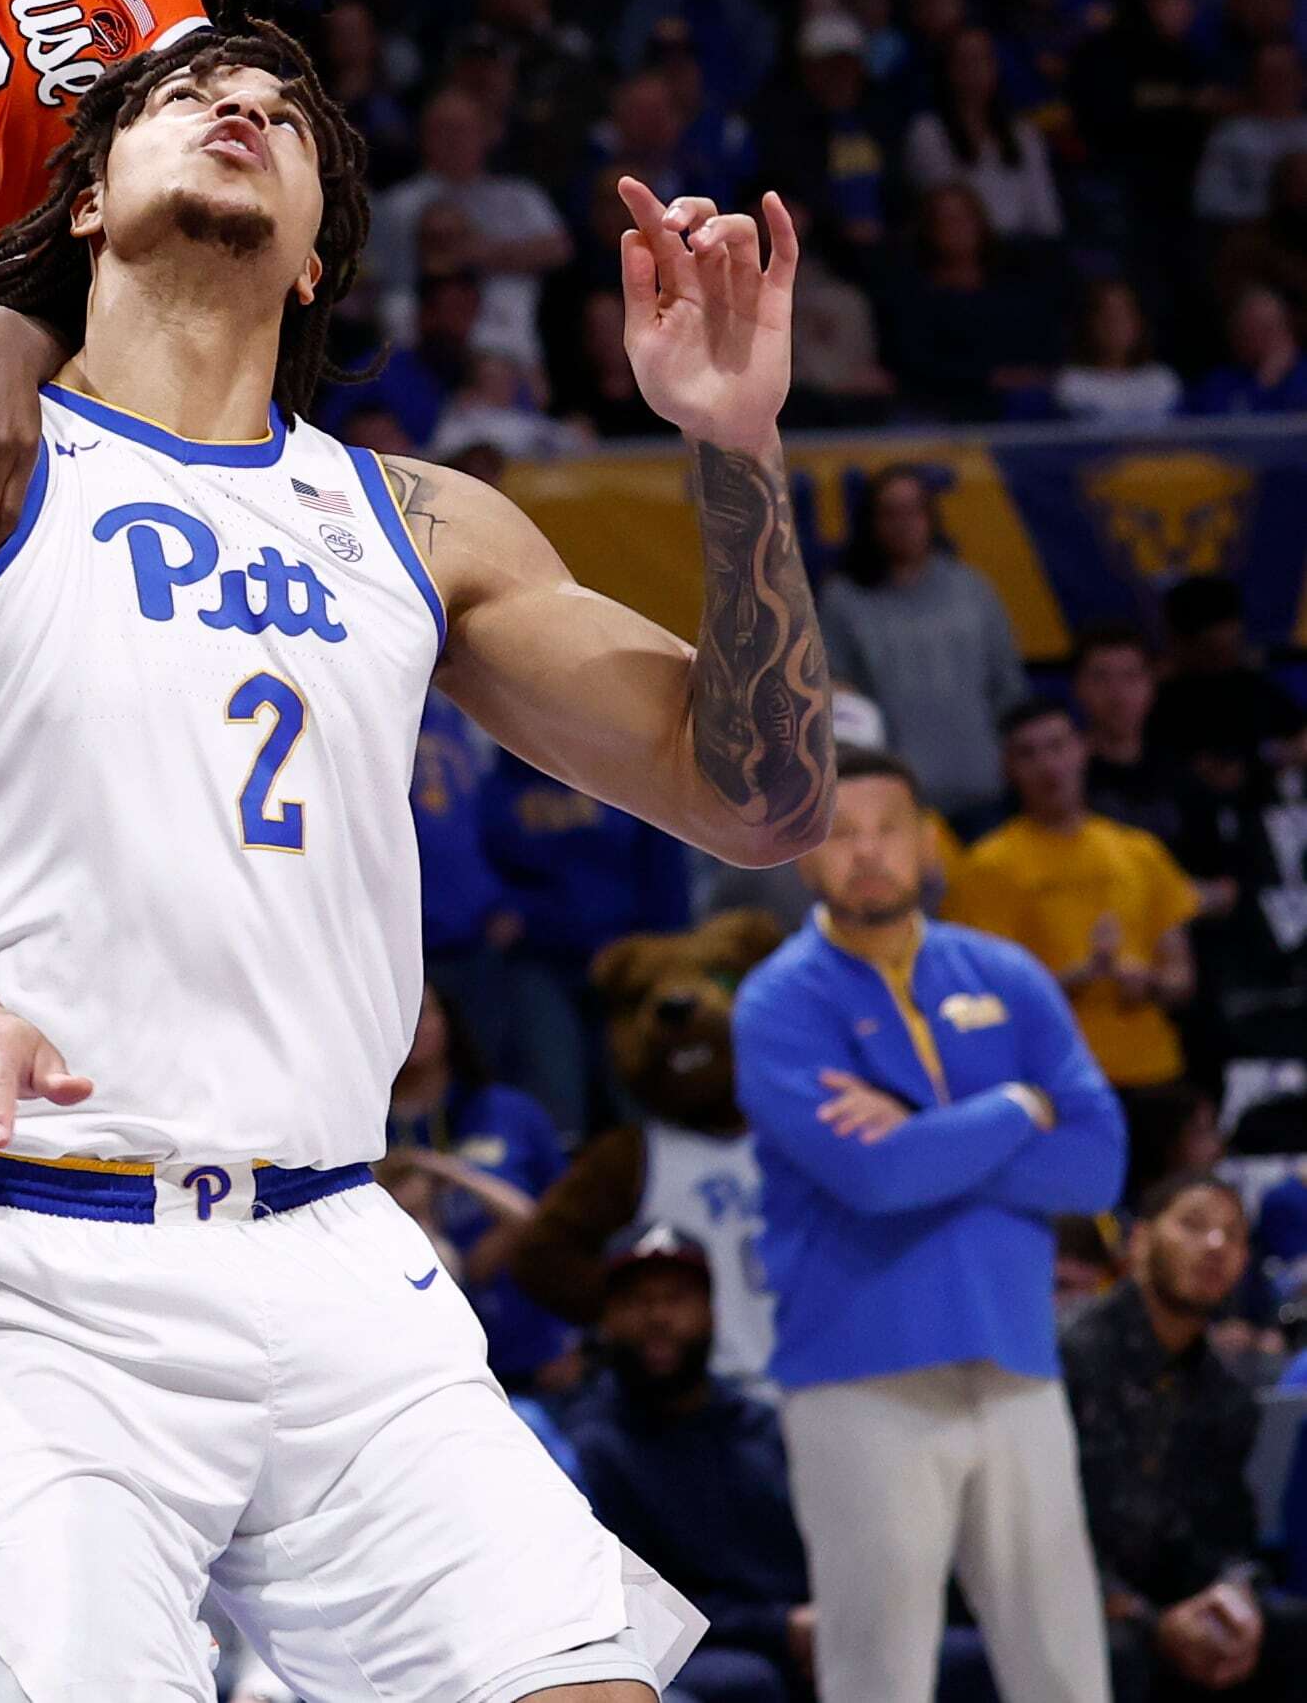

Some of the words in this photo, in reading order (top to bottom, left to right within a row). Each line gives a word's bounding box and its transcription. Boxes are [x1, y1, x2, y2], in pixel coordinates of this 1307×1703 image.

[92, 502, 347, 643] Pitt
[325, 534, 358, 548] ACC
[224, 669, 308, 855] 2
[183, 1165, 231, 1221] P
